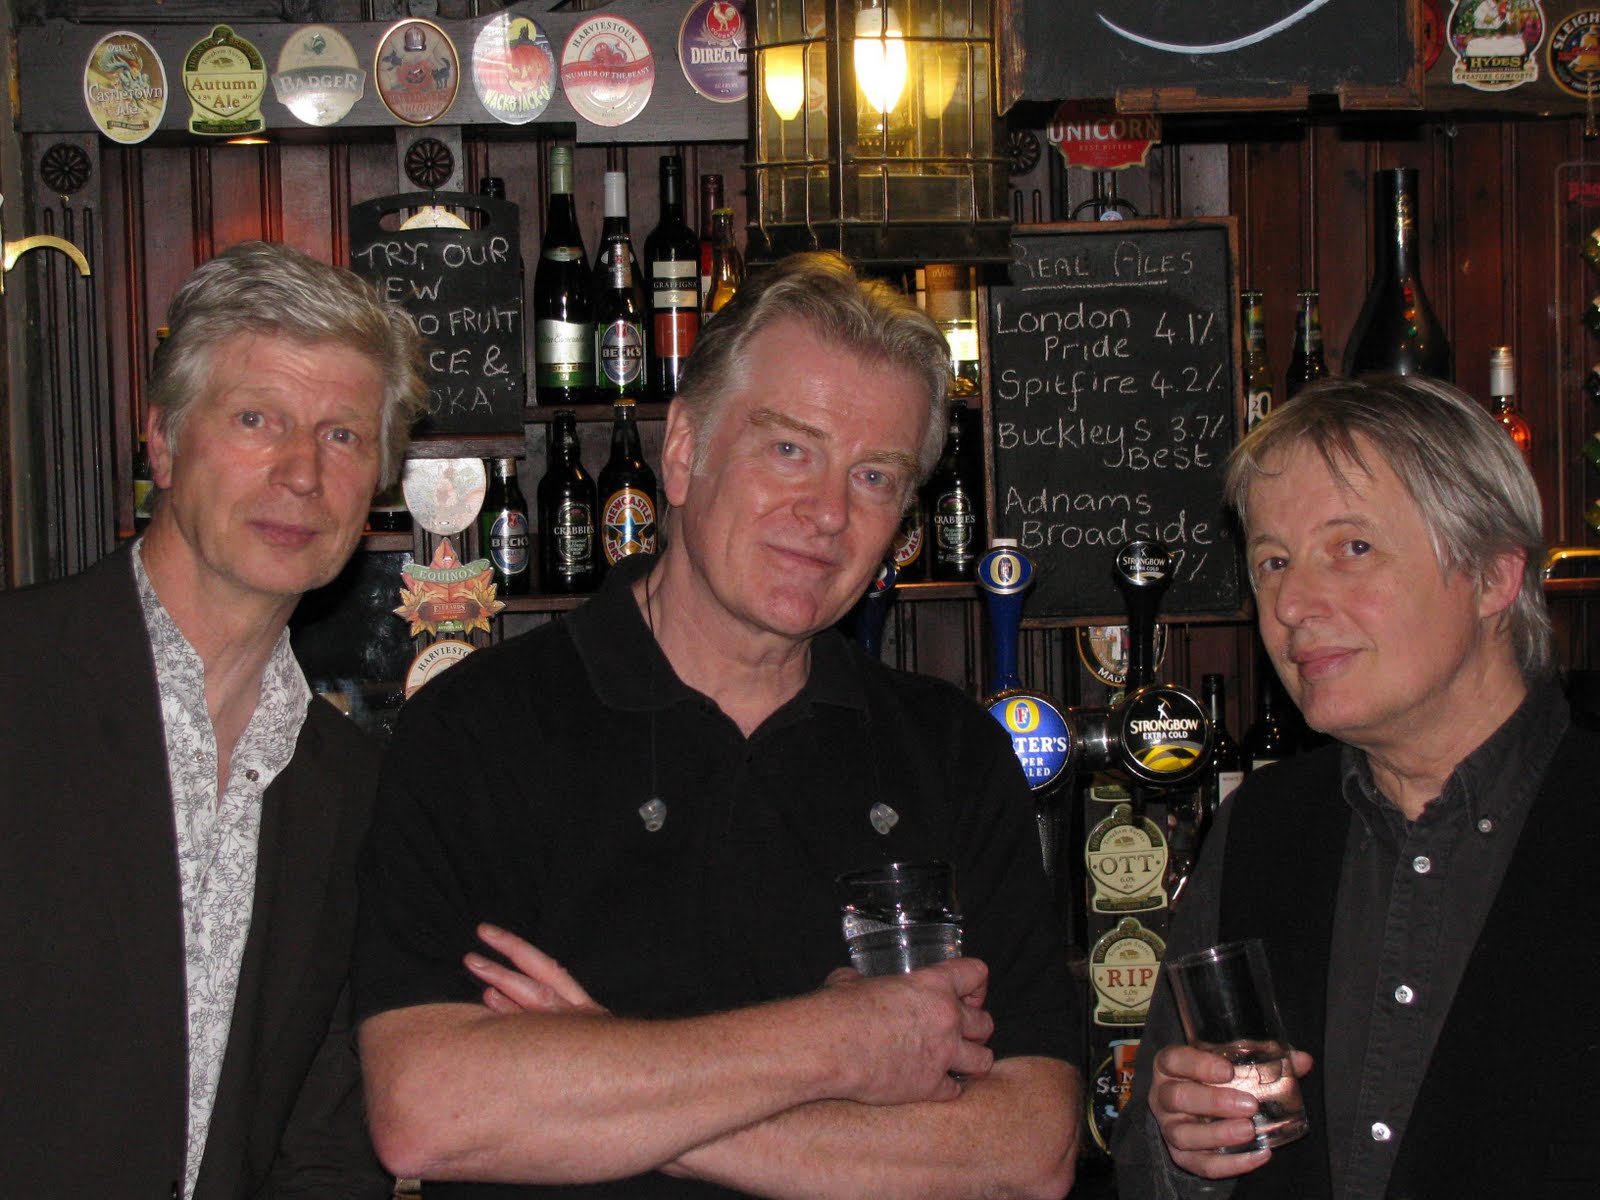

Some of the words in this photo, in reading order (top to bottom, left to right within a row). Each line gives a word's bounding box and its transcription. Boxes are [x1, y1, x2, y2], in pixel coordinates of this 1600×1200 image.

[573, 21, 637, 48] HARVIESTOUN
[1470, 57, 1521, 68] HYDES
[279, 73, 358, 93] BADGER
[565, 70, 598, 81] NUMBER
[611, 71, 627, 79] THE
[627, 66, 650, 79] BEAST
[191, 78, 257, 91] Autumn
[212, 93, 241, 109] Ale
[1047, 118, 1160, 142] UNICORN
[442, 236, 509, 268] OUR
[653, 281, 698, 289] GRAFFIGNA
[449, 305, 519, 336] FRUIT
[997, 302, 1131, 334] London
[602, 346, 642, 358] BECK'S
[1044, 335, 1131, 361] Pride
[430, 350, 471, 375] CE
[483, 345, 510, 377] &
[998, 369, 1138, 412] Spitfire
[1127, 444, 1212, 471] Best
[607, 496, 653, 525] NEWCASTLE
[1005, 486, 1152, 515] Adnams
[553, 525, 595, 536] CRABBIE'S
[1021, 509, 1213, 549] Broadside
[491, 536, 529, 548] BECK'S
[908, 532, 920, 552] ALE
[1122, 556, 1166, 567] STRONGBOW
[420, 568, 478, 581] EQUINOX
[418, 646, 470, 672] HARVIESTO
[1130, 719, 1199, 735] STRONGBOW
[1142, 732, 1167, 740] EXTRA
[1168, 731, 1189, 739] COLD
[1014, 736, 1067, 753] TER'S
[1021, 757, 1044, 767] PER
[1100, 855, 1155, 876] OTT
[1107, 968, 1153, 988] RIP
